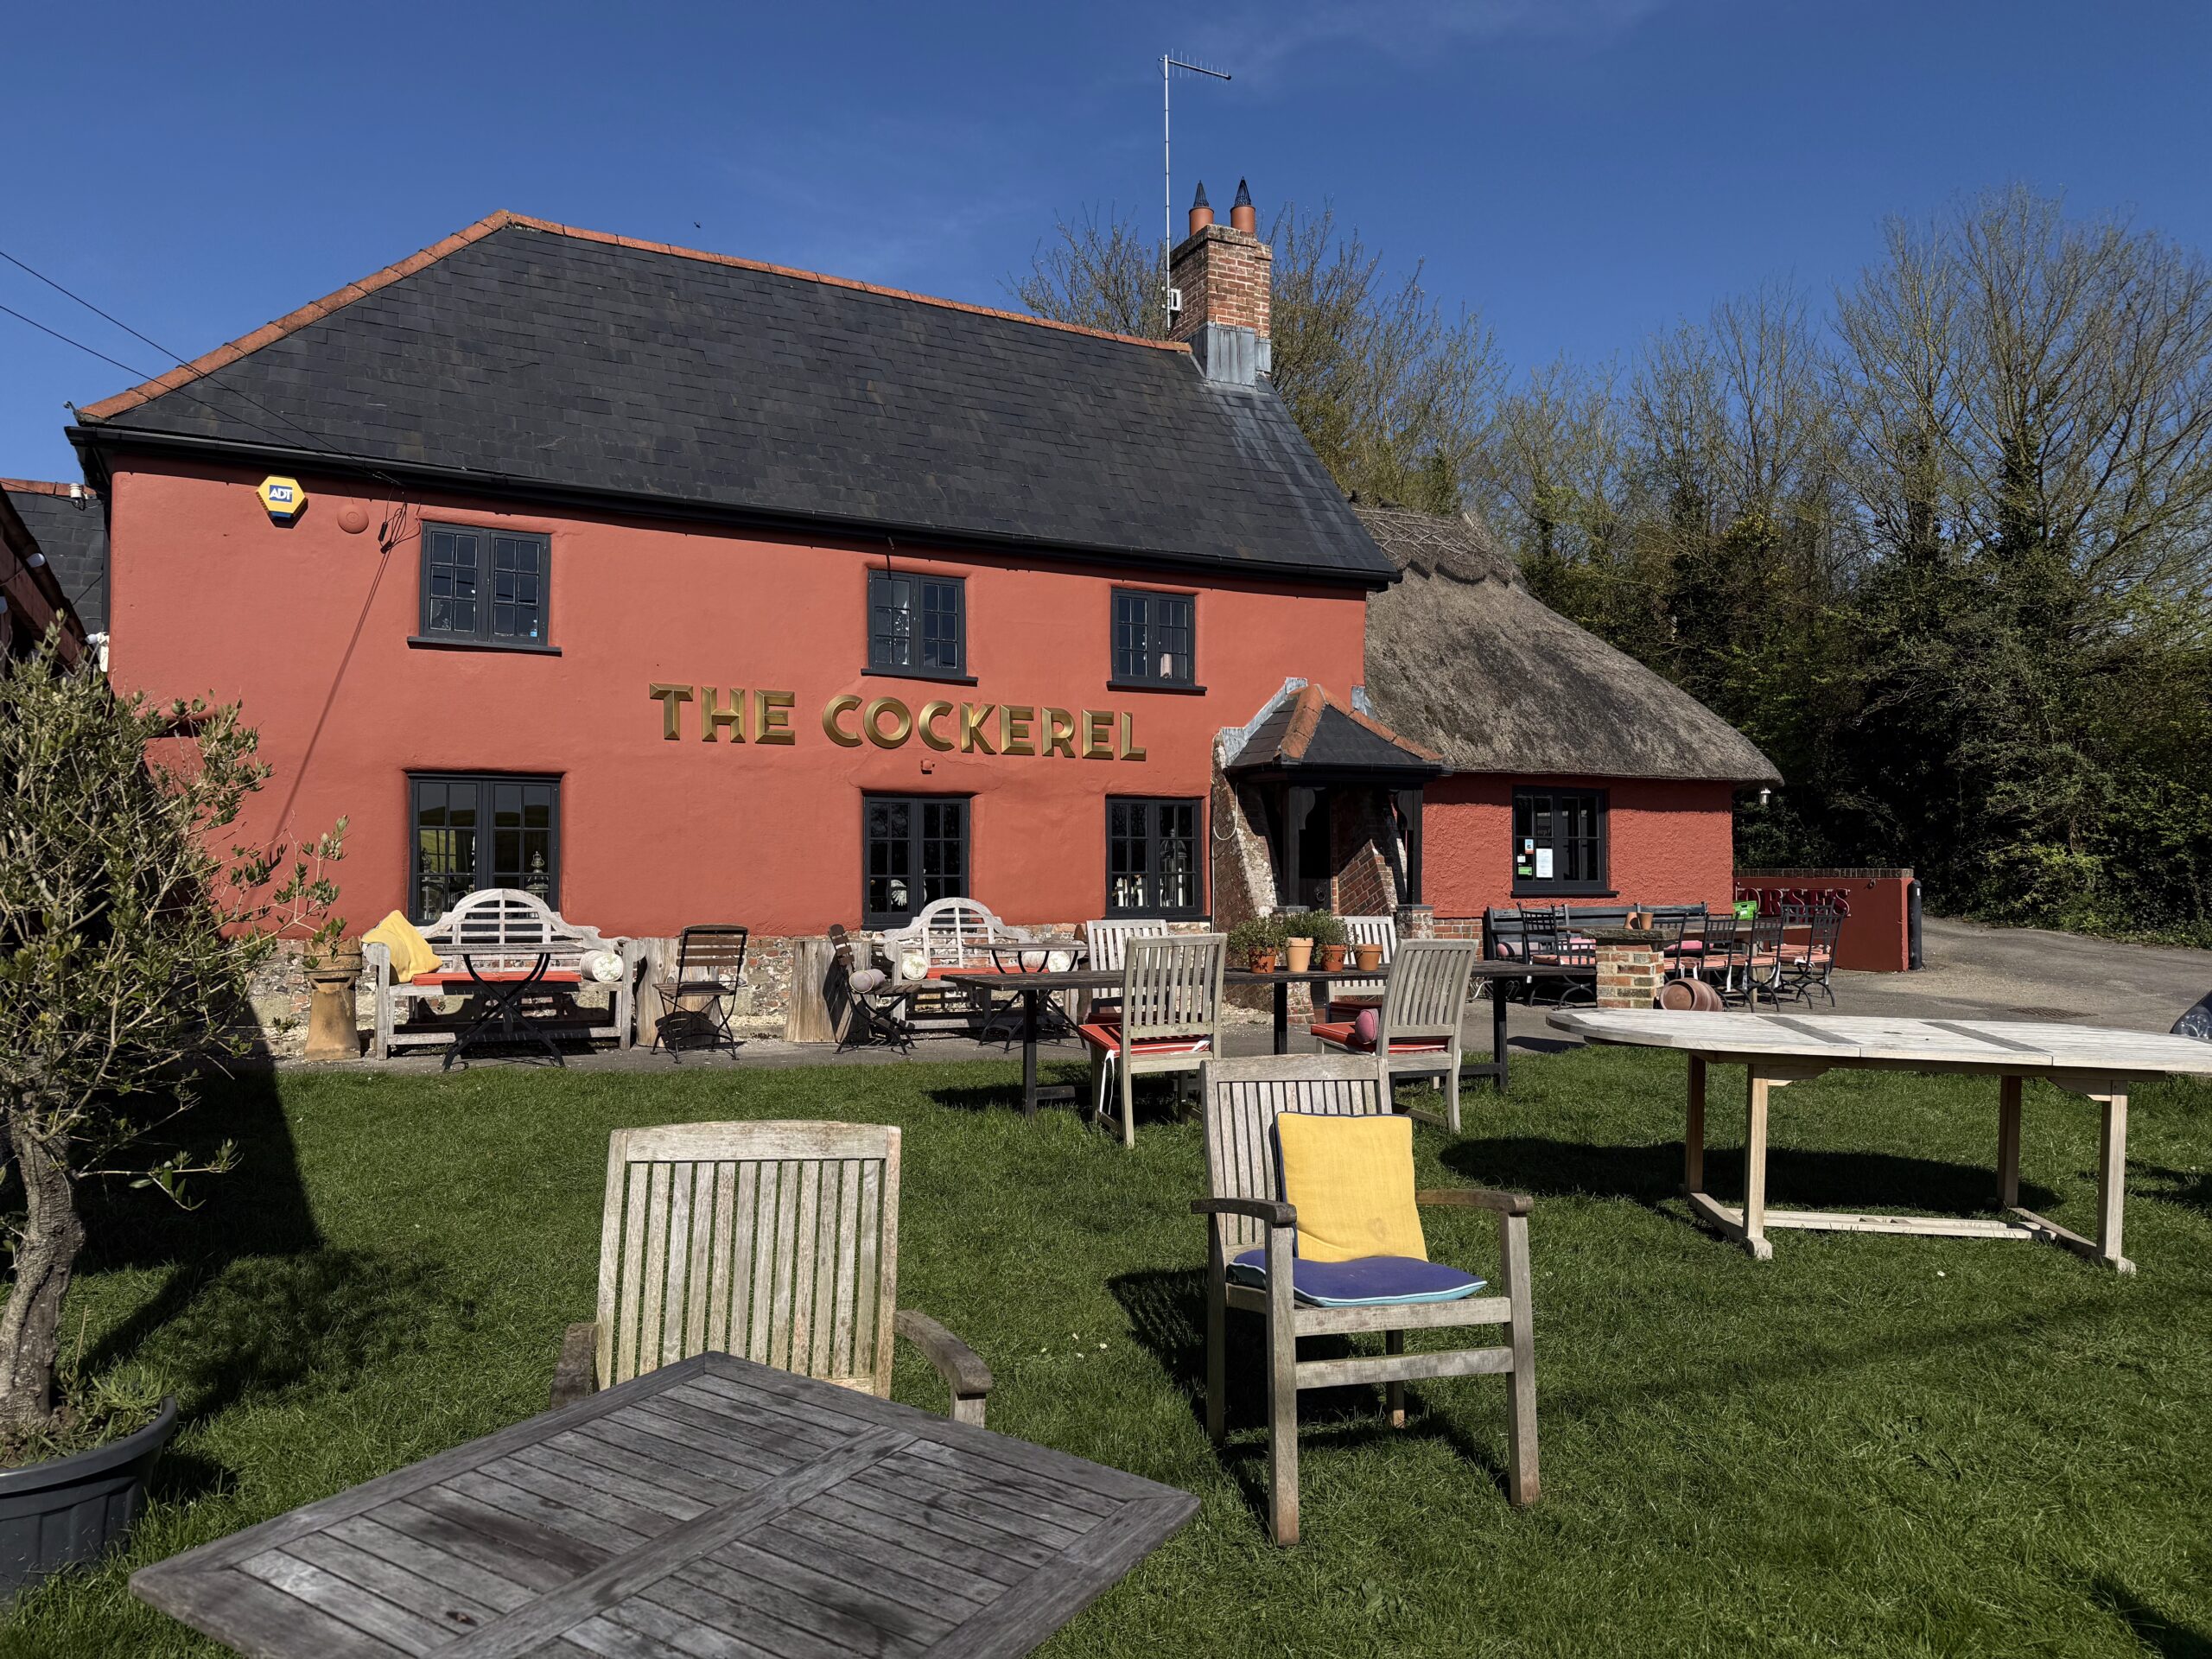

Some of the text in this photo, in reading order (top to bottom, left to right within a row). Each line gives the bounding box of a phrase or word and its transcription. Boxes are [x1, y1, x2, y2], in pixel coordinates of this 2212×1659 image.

[270, 487, 293, 499] ADT
[649, 682, 1147, 762] THE COCKEREL
[1734, 886, 1851, 917] ORSES
